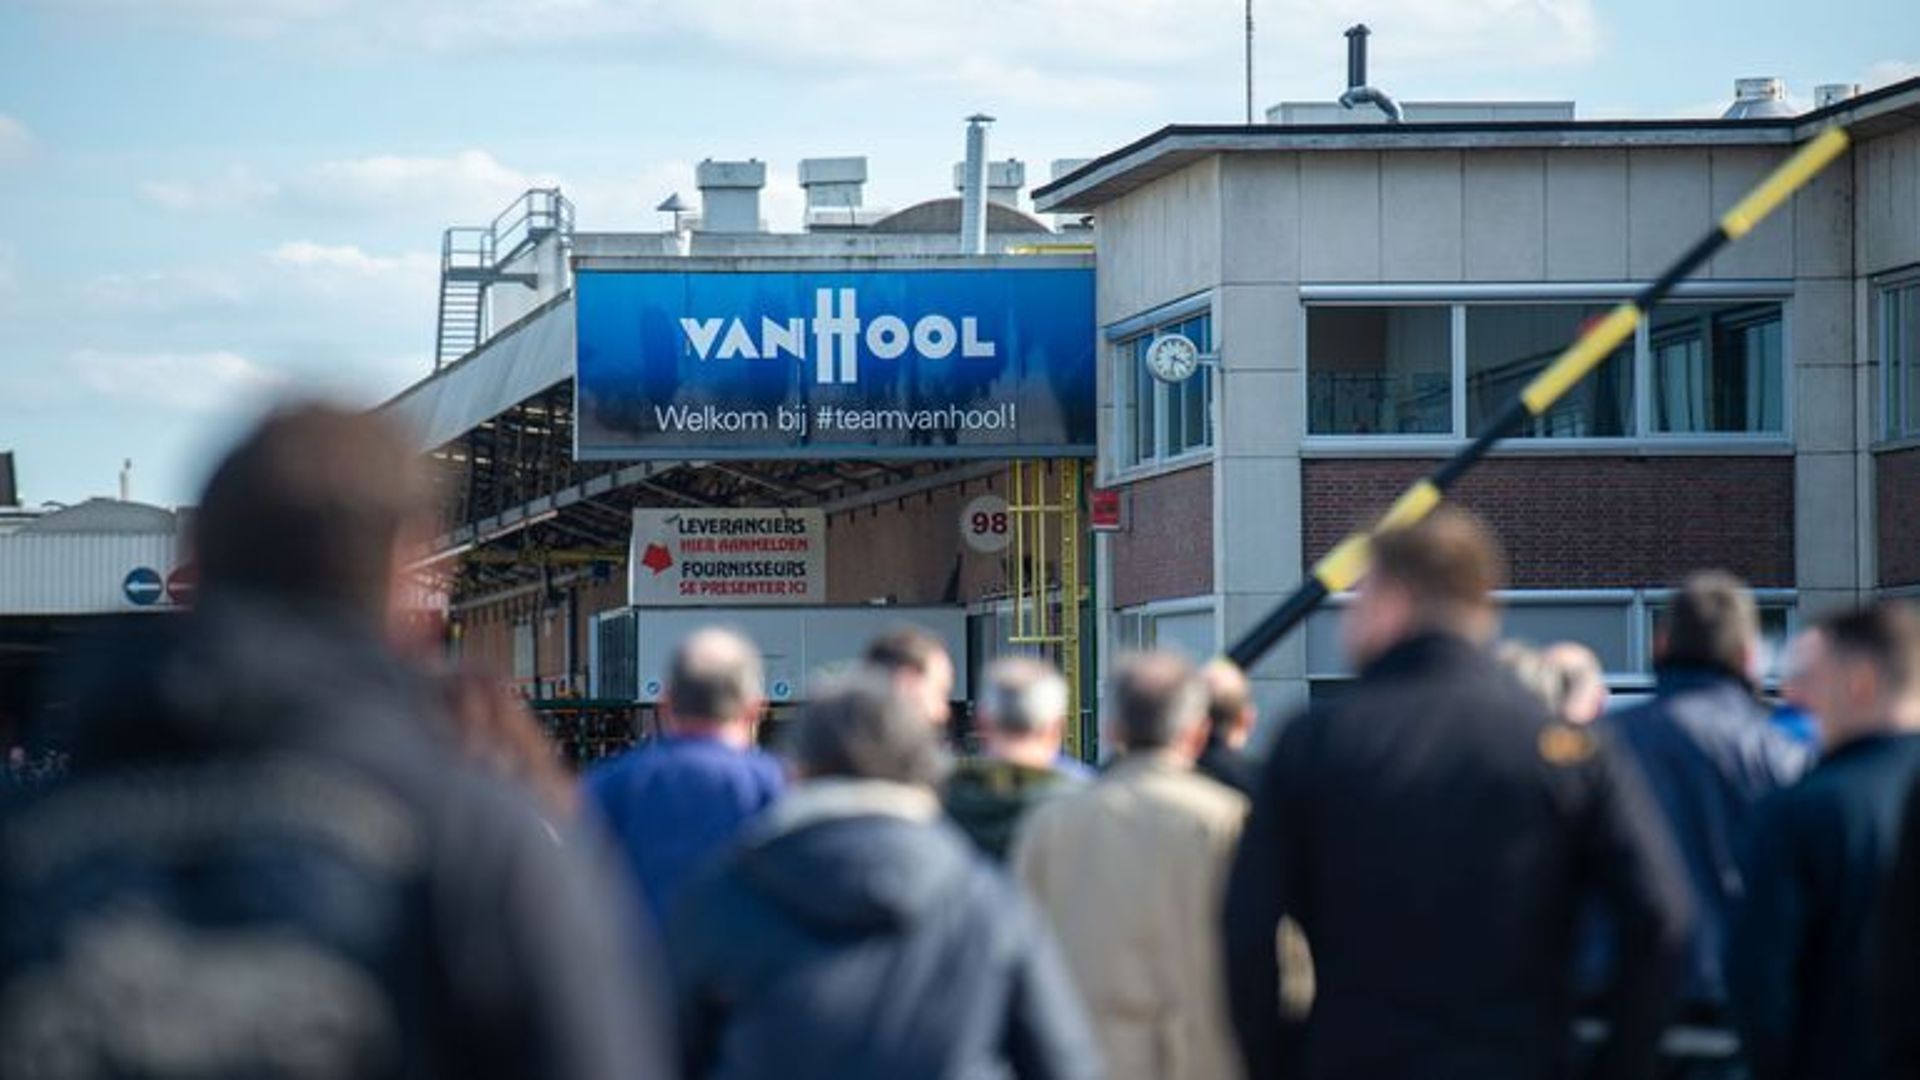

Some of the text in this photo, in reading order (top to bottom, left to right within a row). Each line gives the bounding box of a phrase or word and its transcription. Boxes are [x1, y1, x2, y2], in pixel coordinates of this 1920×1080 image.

[654, 403, 1016, 437] Welkom bij #teamvanhool!
[679, 517, 806, 535] LEVERANCIERS
[971, 512, 1008, 535] 98
[680, 537, 809, 552] HIER AANMELDEN
[681, 561, 806, 578] FOURNISSEURS
[679, 580, 696, 595] SE
